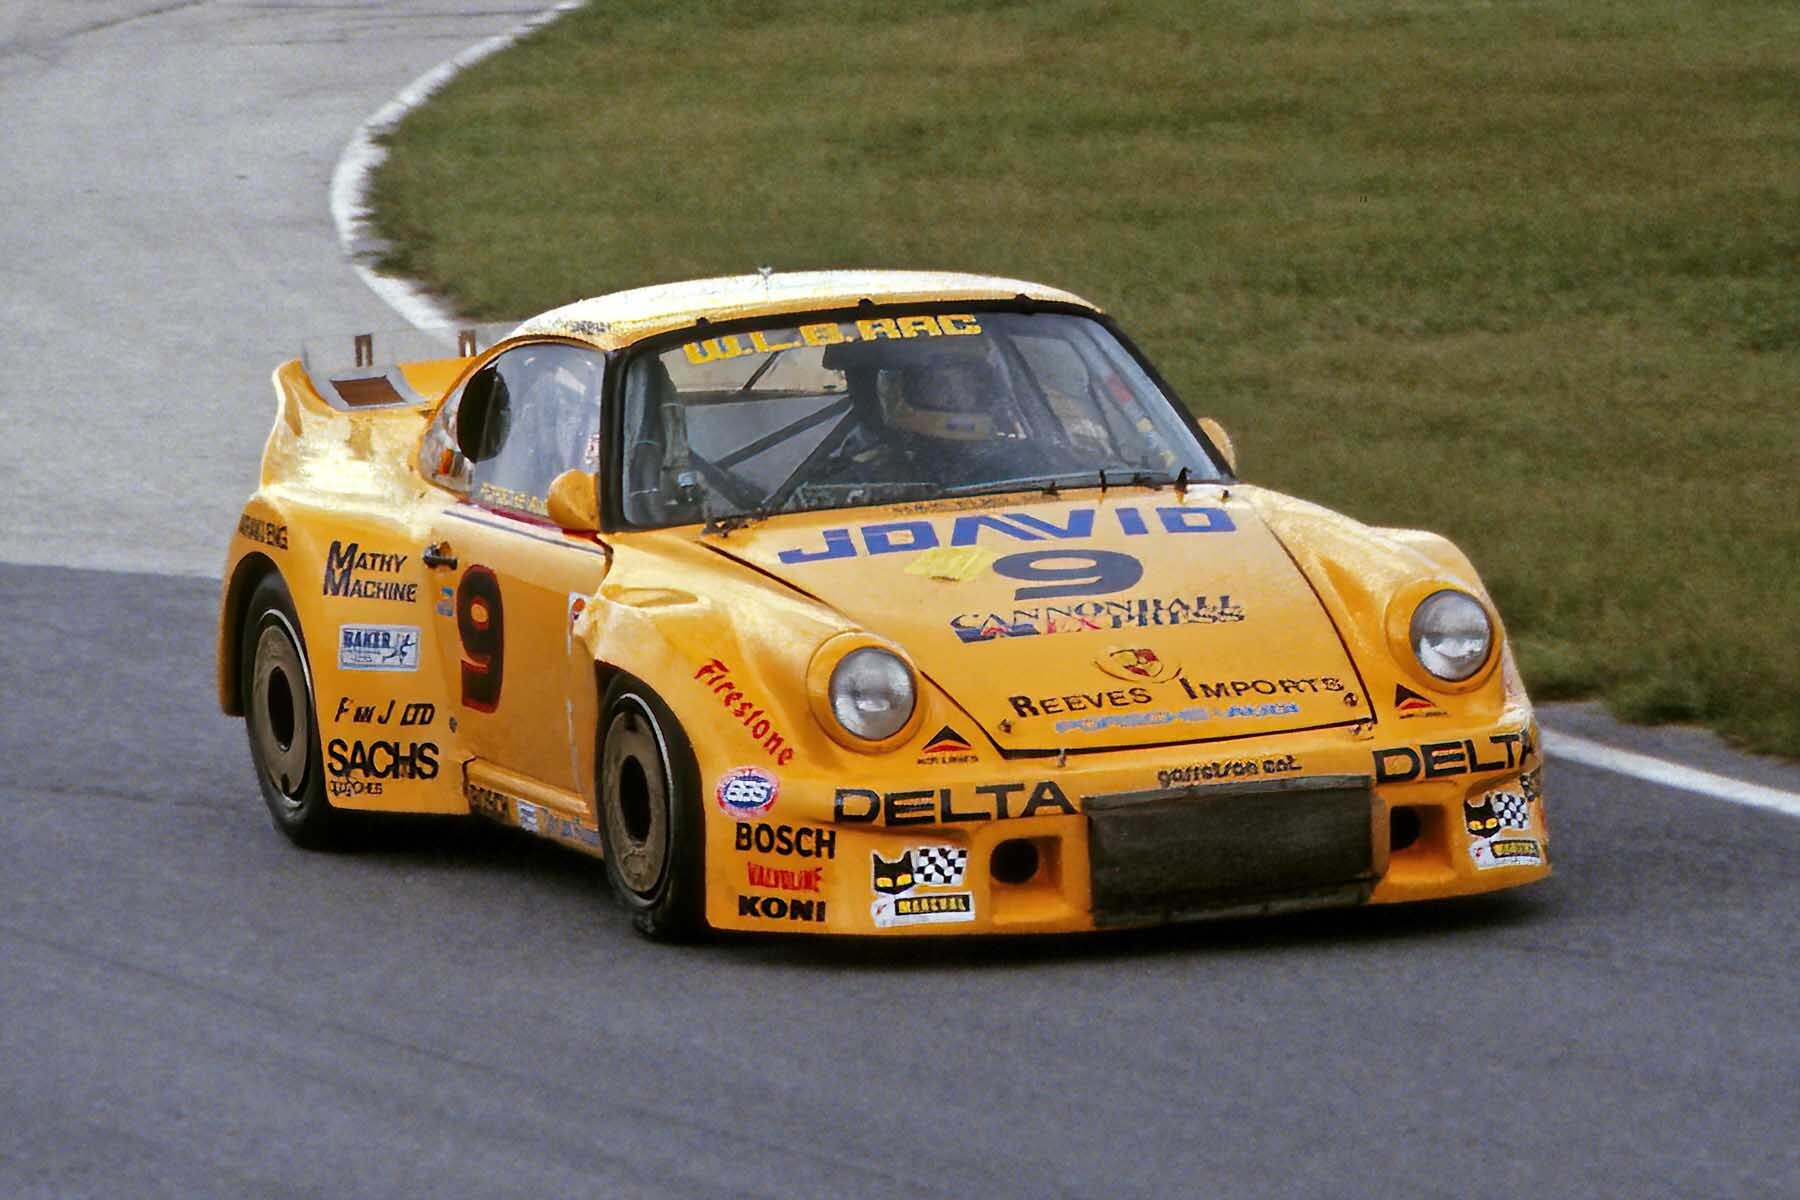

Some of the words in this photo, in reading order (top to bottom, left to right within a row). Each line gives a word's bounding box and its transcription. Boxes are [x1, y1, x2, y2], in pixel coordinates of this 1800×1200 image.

[992, 549, 1143, 600] 9
[456, 564, 504, 714] 9
[693, 658, 795, 766] Firestone
[327, 738, 440, 780] SACHS
[834, 781, 1081, 827] DELTA
[735, 822, 836, 859] BOSCH
[738, 895, 826, 922] KONI
